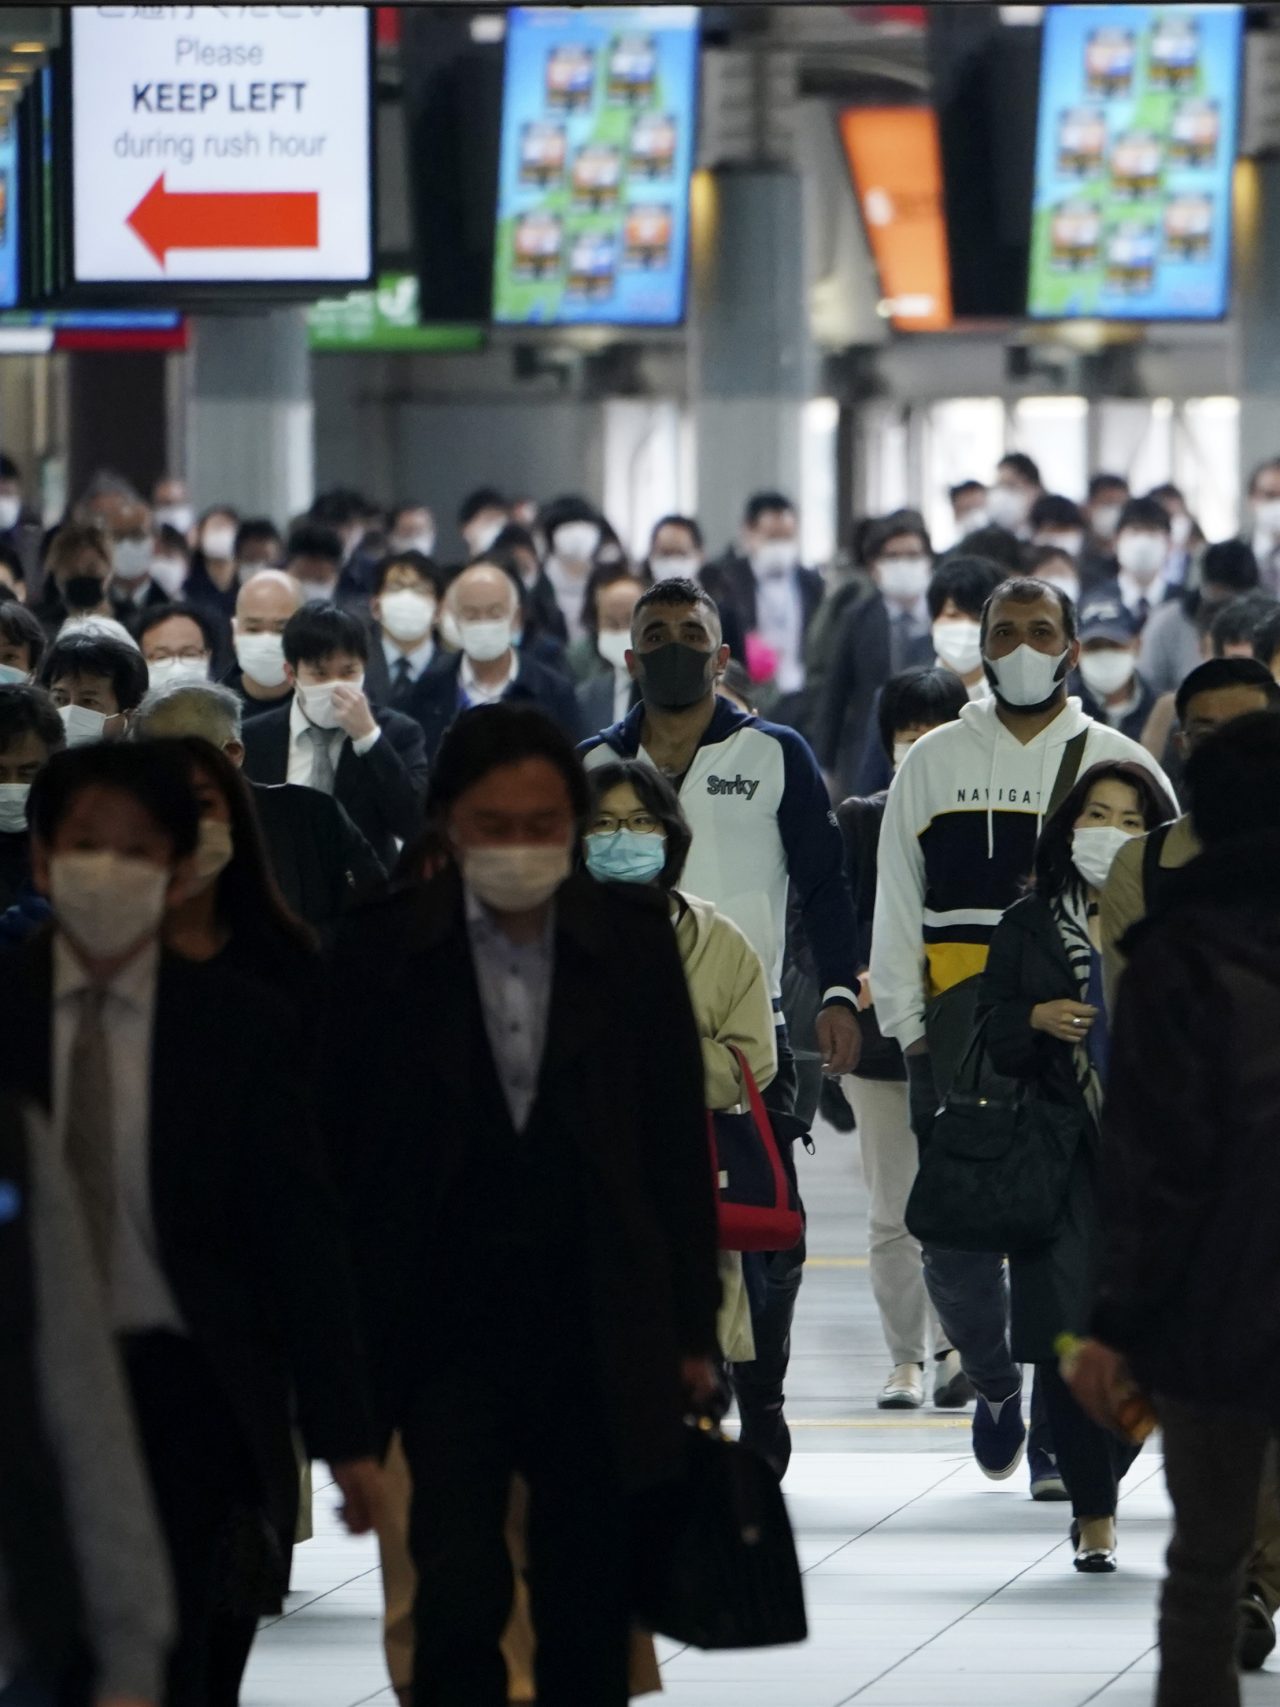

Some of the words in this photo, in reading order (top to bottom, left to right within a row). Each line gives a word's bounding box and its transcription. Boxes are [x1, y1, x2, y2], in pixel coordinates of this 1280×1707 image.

[176, 38, 263, 66] Please
[133, 83, 218, 112] KEEP
[229, 82, 306, 112] LEFT
[114, 132, 194, 163] during
[204, 132, 260, 158] rush
[270, 132, 326, 158] hour
